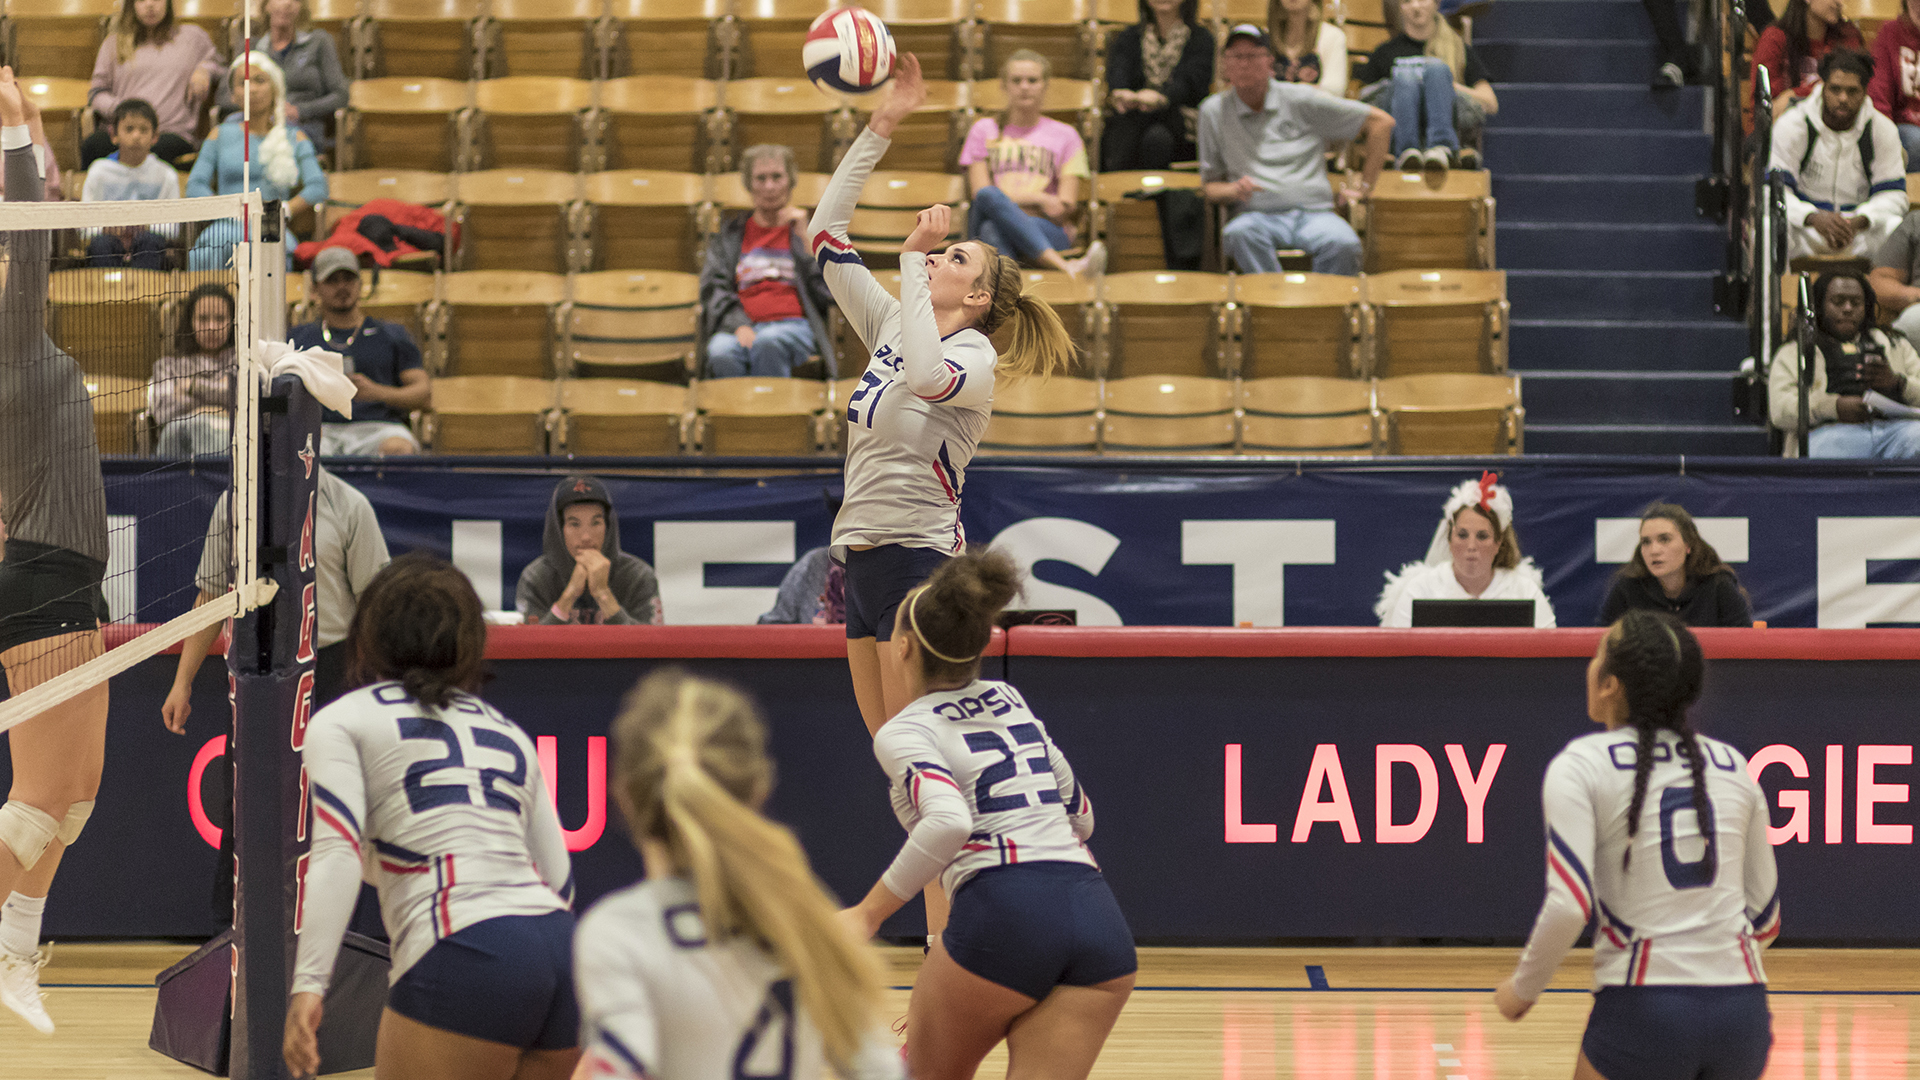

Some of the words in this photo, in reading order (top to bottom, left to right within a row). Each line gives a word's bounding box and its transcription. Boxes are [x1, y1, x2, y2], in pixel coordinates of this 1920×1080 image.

[847, 370, 895, 430] 21
[932, 685, 1024, 721] OPSU
[395, 716, 527, 815] 22
[961, 721, 1064, 815] 23
[1225, 743, 1507, 843] LADY
[1745, 743, 1914, 846] GIE
